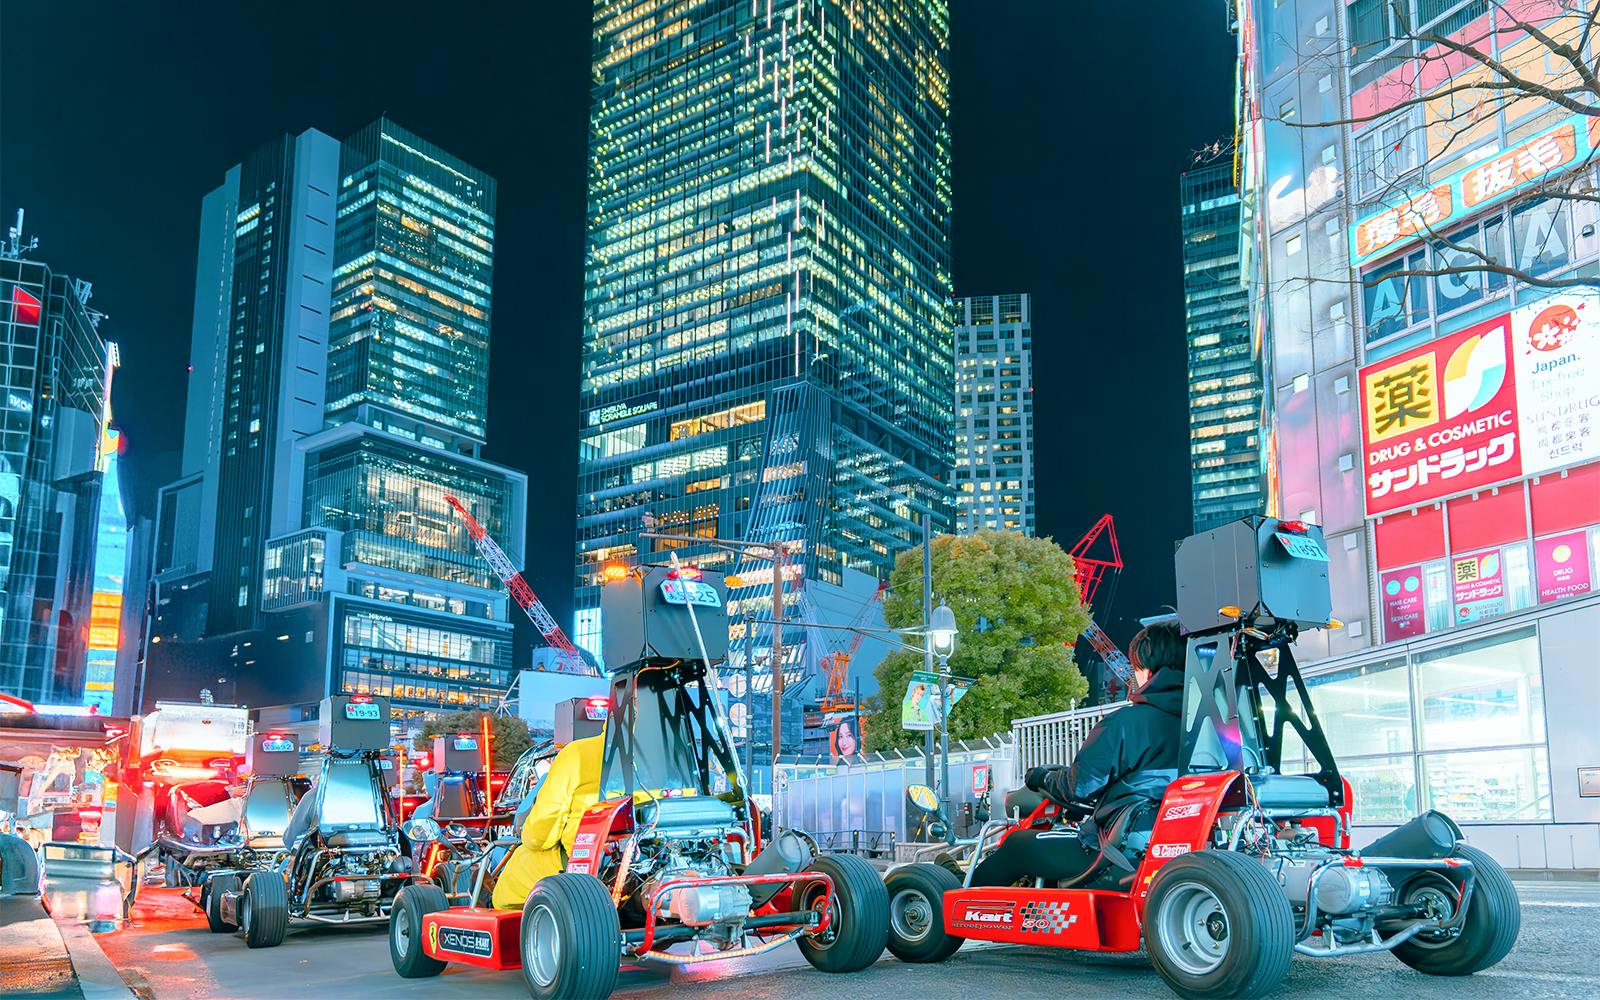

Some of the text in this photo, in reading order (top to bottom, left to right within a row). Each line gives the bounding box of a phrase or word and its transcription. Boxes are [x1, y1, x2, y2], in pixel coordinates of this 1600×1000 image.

[1373, 362, 1432, 435] 薬
[632, 401, 658, 416] SQUARE
[1369, 409, 1513, 466] DRUG & COSMETIC
[1456, 560, 1477, 581] 薬
[1552, 567, 1574, 577] DRUG
[964, 911, 1014, 923] Kart
